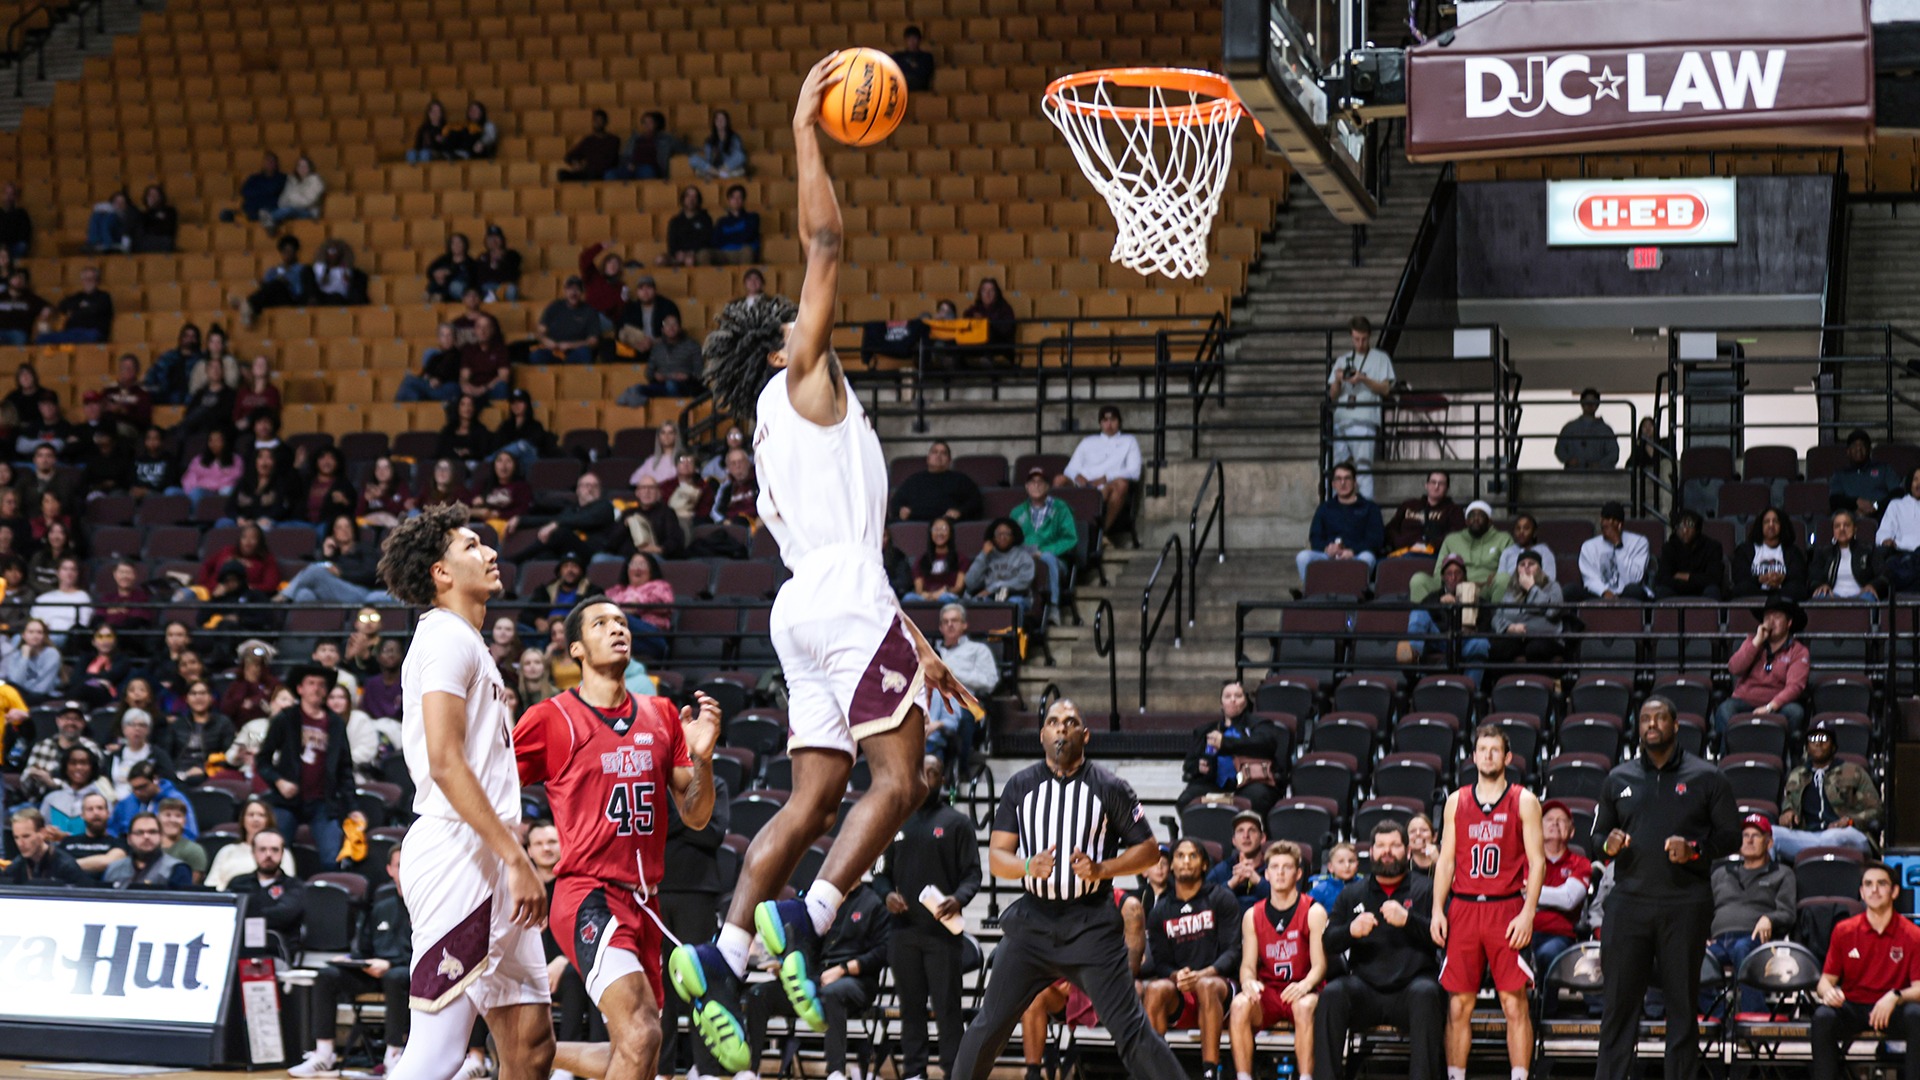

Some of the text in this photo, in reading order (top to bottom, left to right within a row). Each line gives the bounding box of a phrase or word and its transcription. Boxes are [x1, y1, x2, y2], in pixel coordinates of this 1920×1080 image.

[1465, 49, 1786, 118] DJC LAW
[605, 782, 655, 836] 45
[1470, 843, 1500, 879] 10
[1165, 910, 1214, 938] A-STATE
[62, 923, 210, 997] Hut
